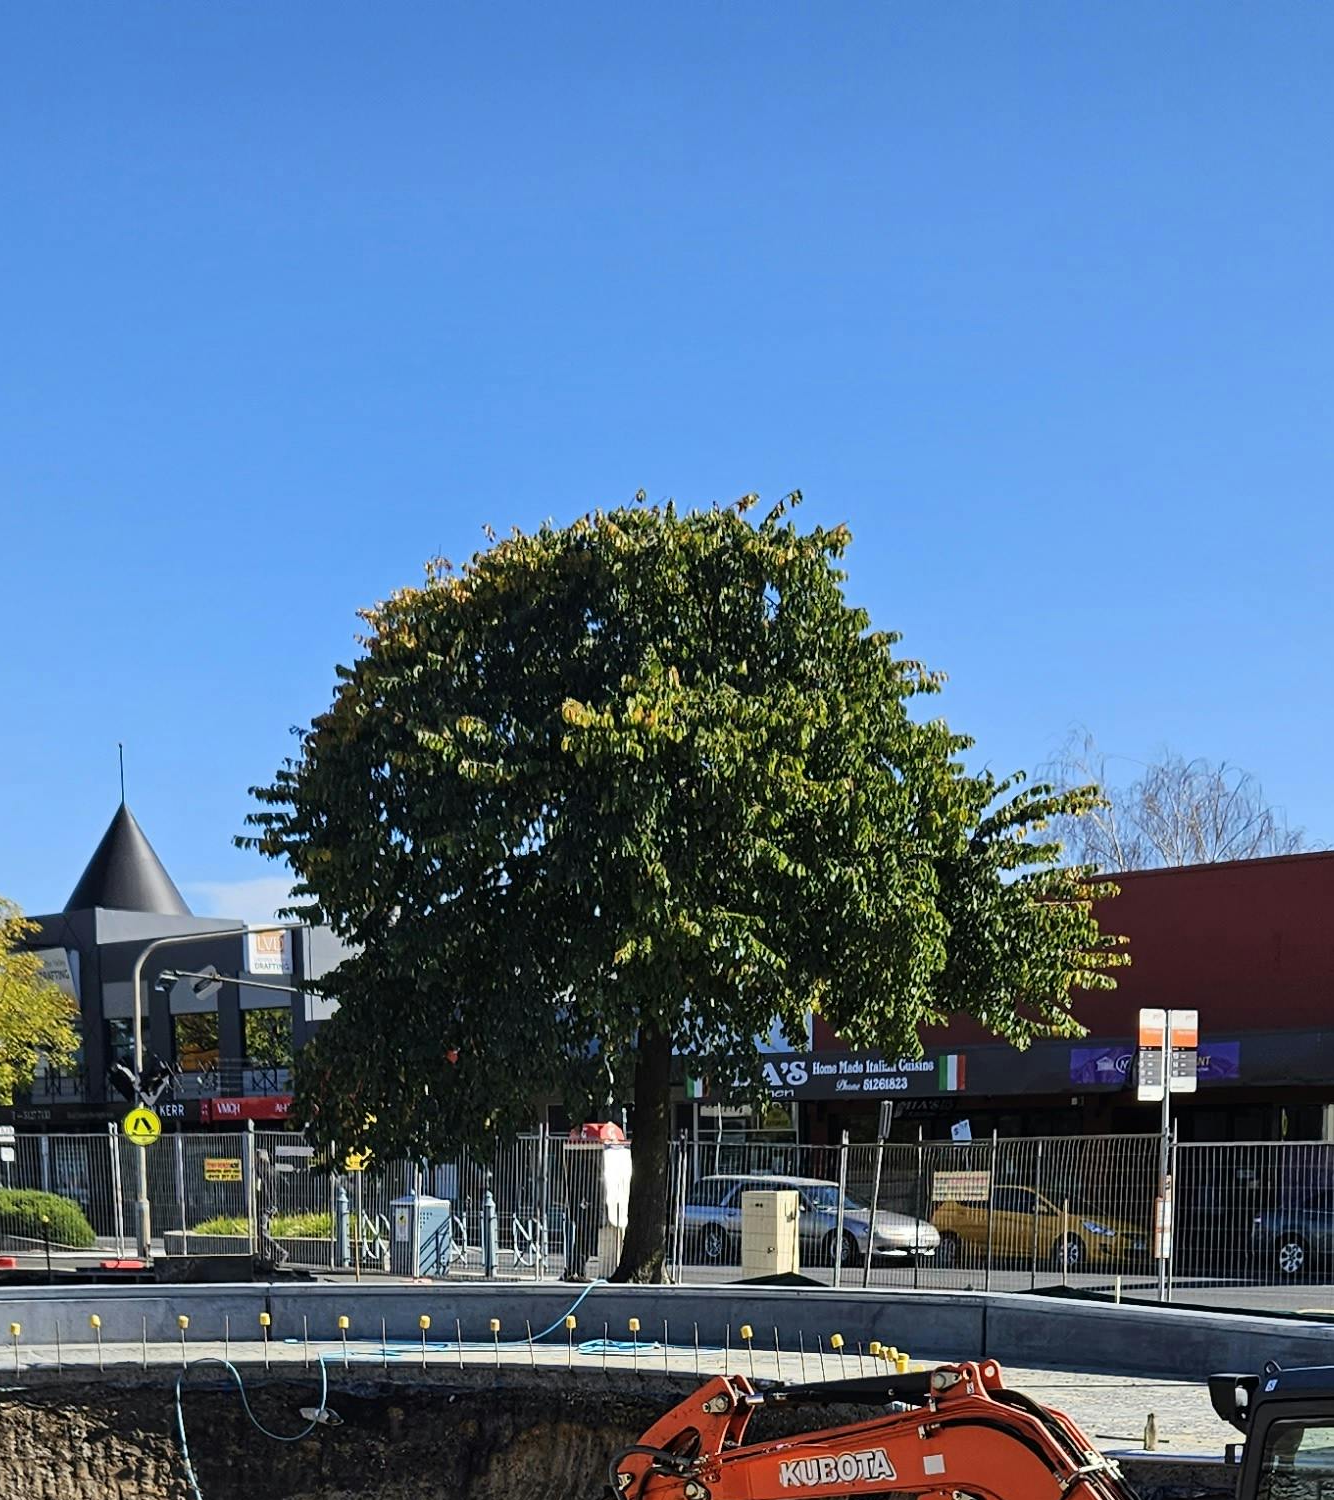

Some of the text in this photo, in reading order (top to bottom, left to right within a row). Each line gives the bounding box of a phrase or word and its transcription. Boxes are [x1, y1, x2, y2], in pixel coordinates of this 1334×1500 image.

[812, 1062, 837, 1075] Home
[839, 1059, 864, 1074] Made
[159, 1104, 185, 1117] KERR
[780, 1449, 896, 1487] KUBOTA
